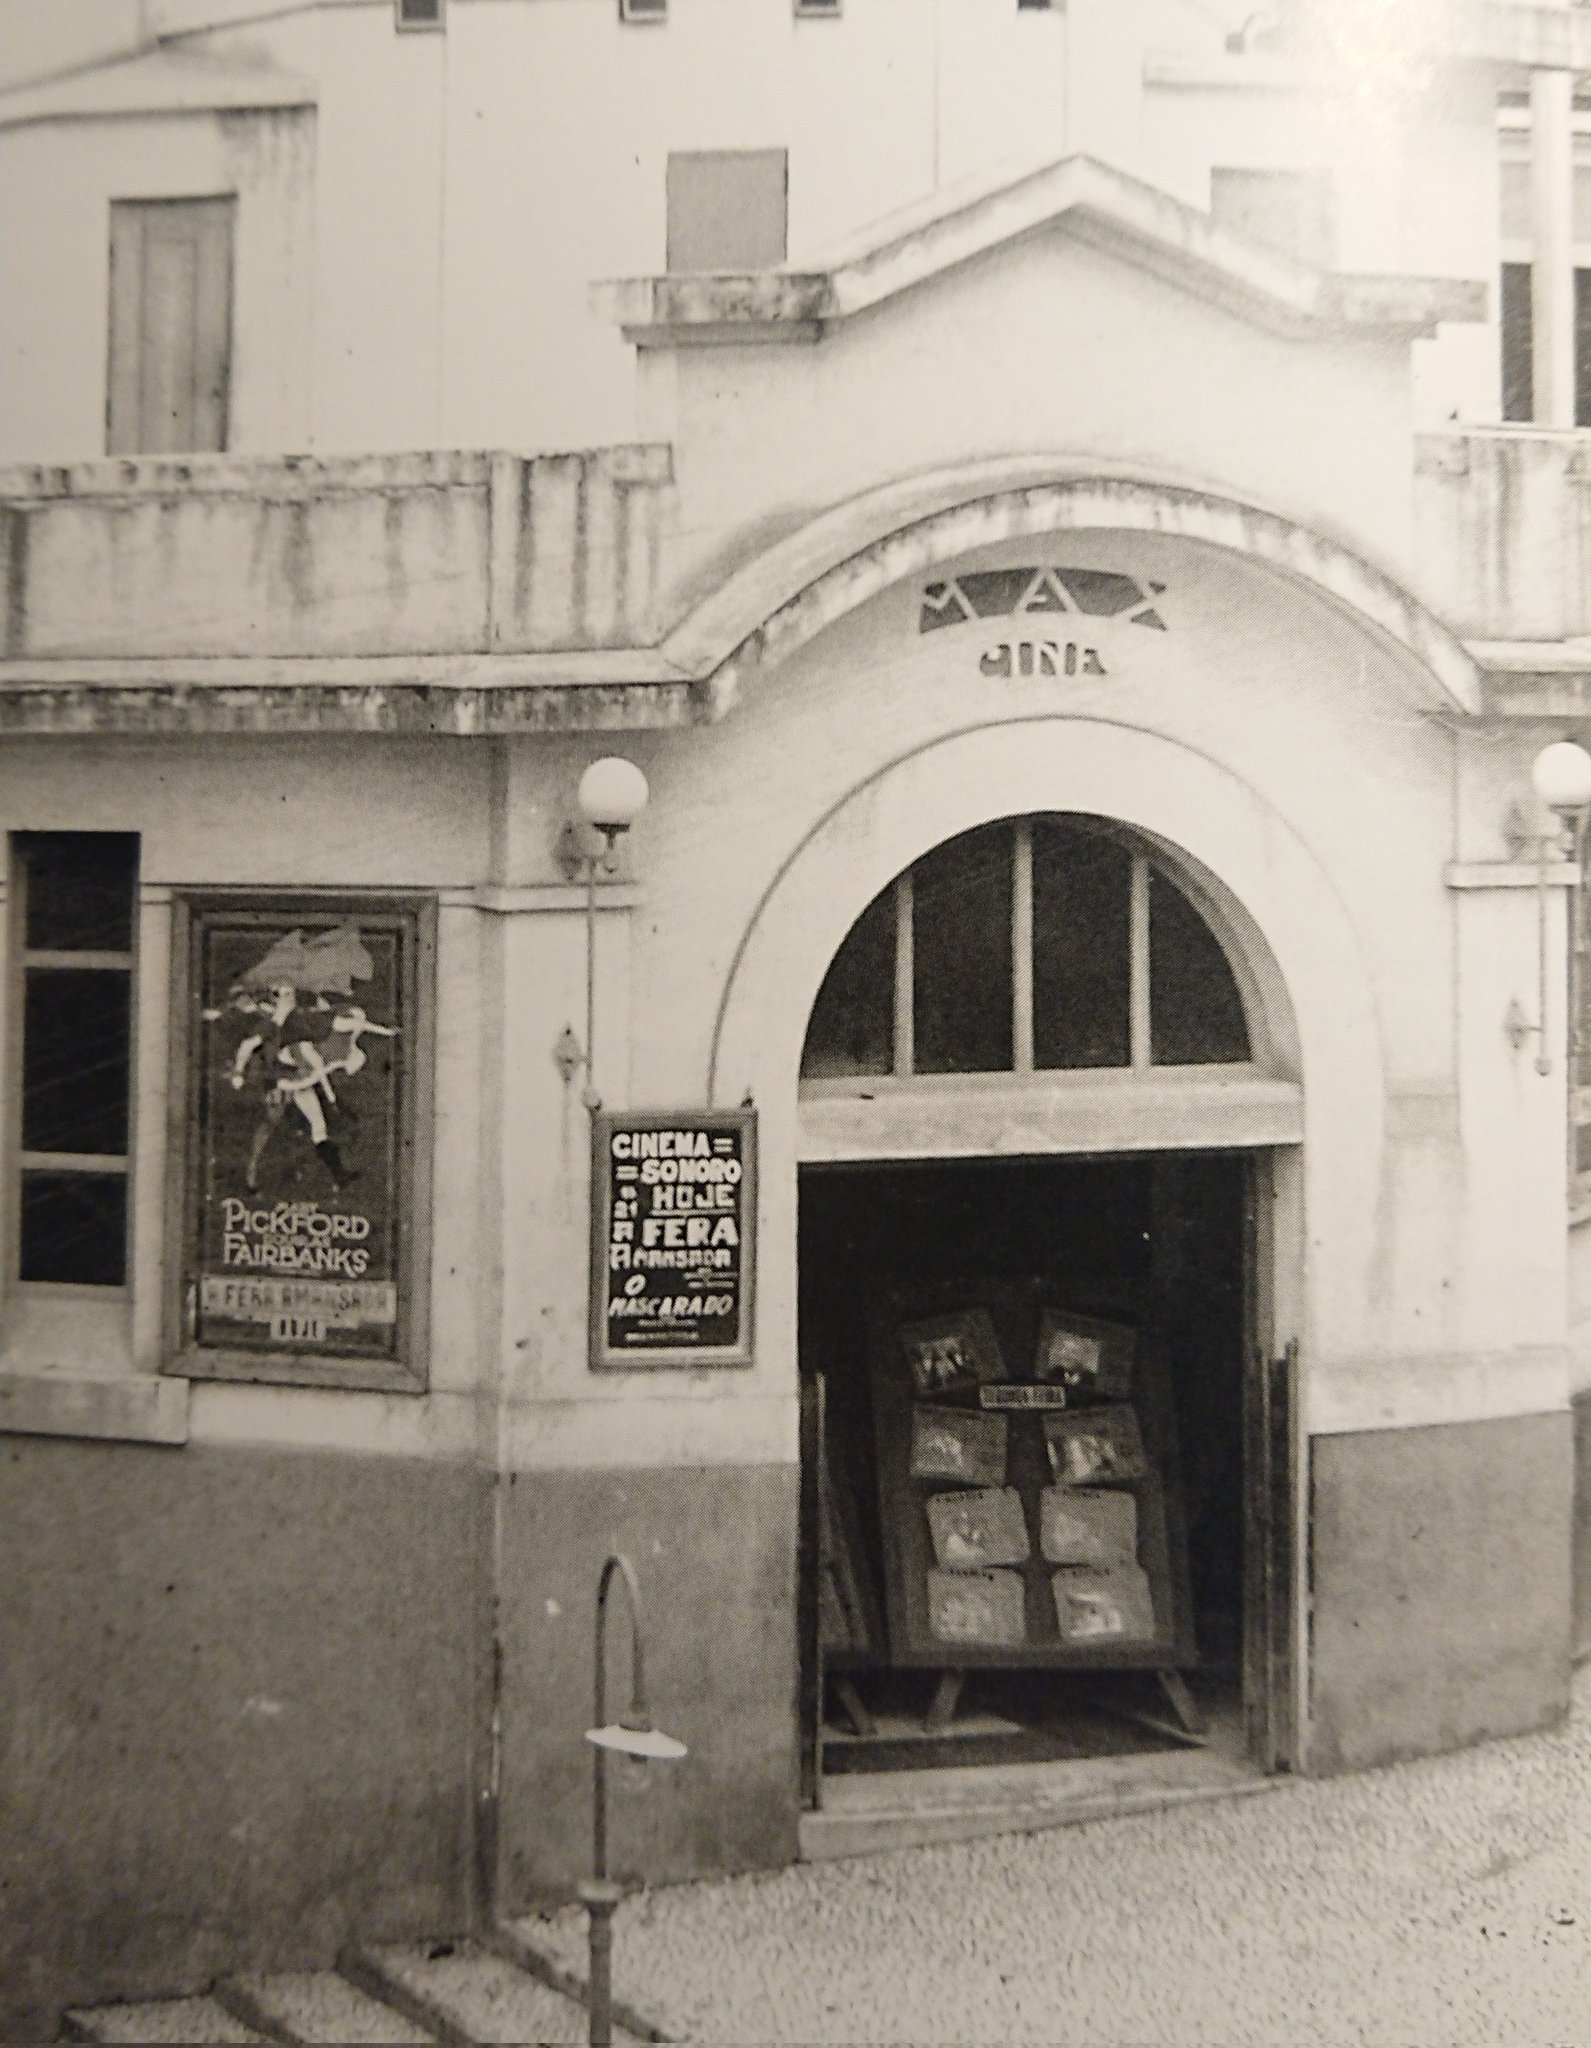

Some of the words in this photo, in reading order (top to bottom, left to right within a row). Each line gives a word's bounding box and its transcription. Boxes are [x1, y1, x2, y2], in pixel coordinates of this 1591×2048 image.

[978, 640, 1108, 677] CINE
[611, 1131, 712, 1159] CINEMA
[640, 1158, 742, 1184] SONORO
[652, 1184, 735, 1209] HOJE
[221, 1197, 370, 1240] PICKFORD
[642, 1217, 739, 1247] FERA
[223, 1232, 370, 1278] FAIRBANKS
[624, 1273, 647, 1296] O
[609, 1294, 734, 1317] MASCARADO
